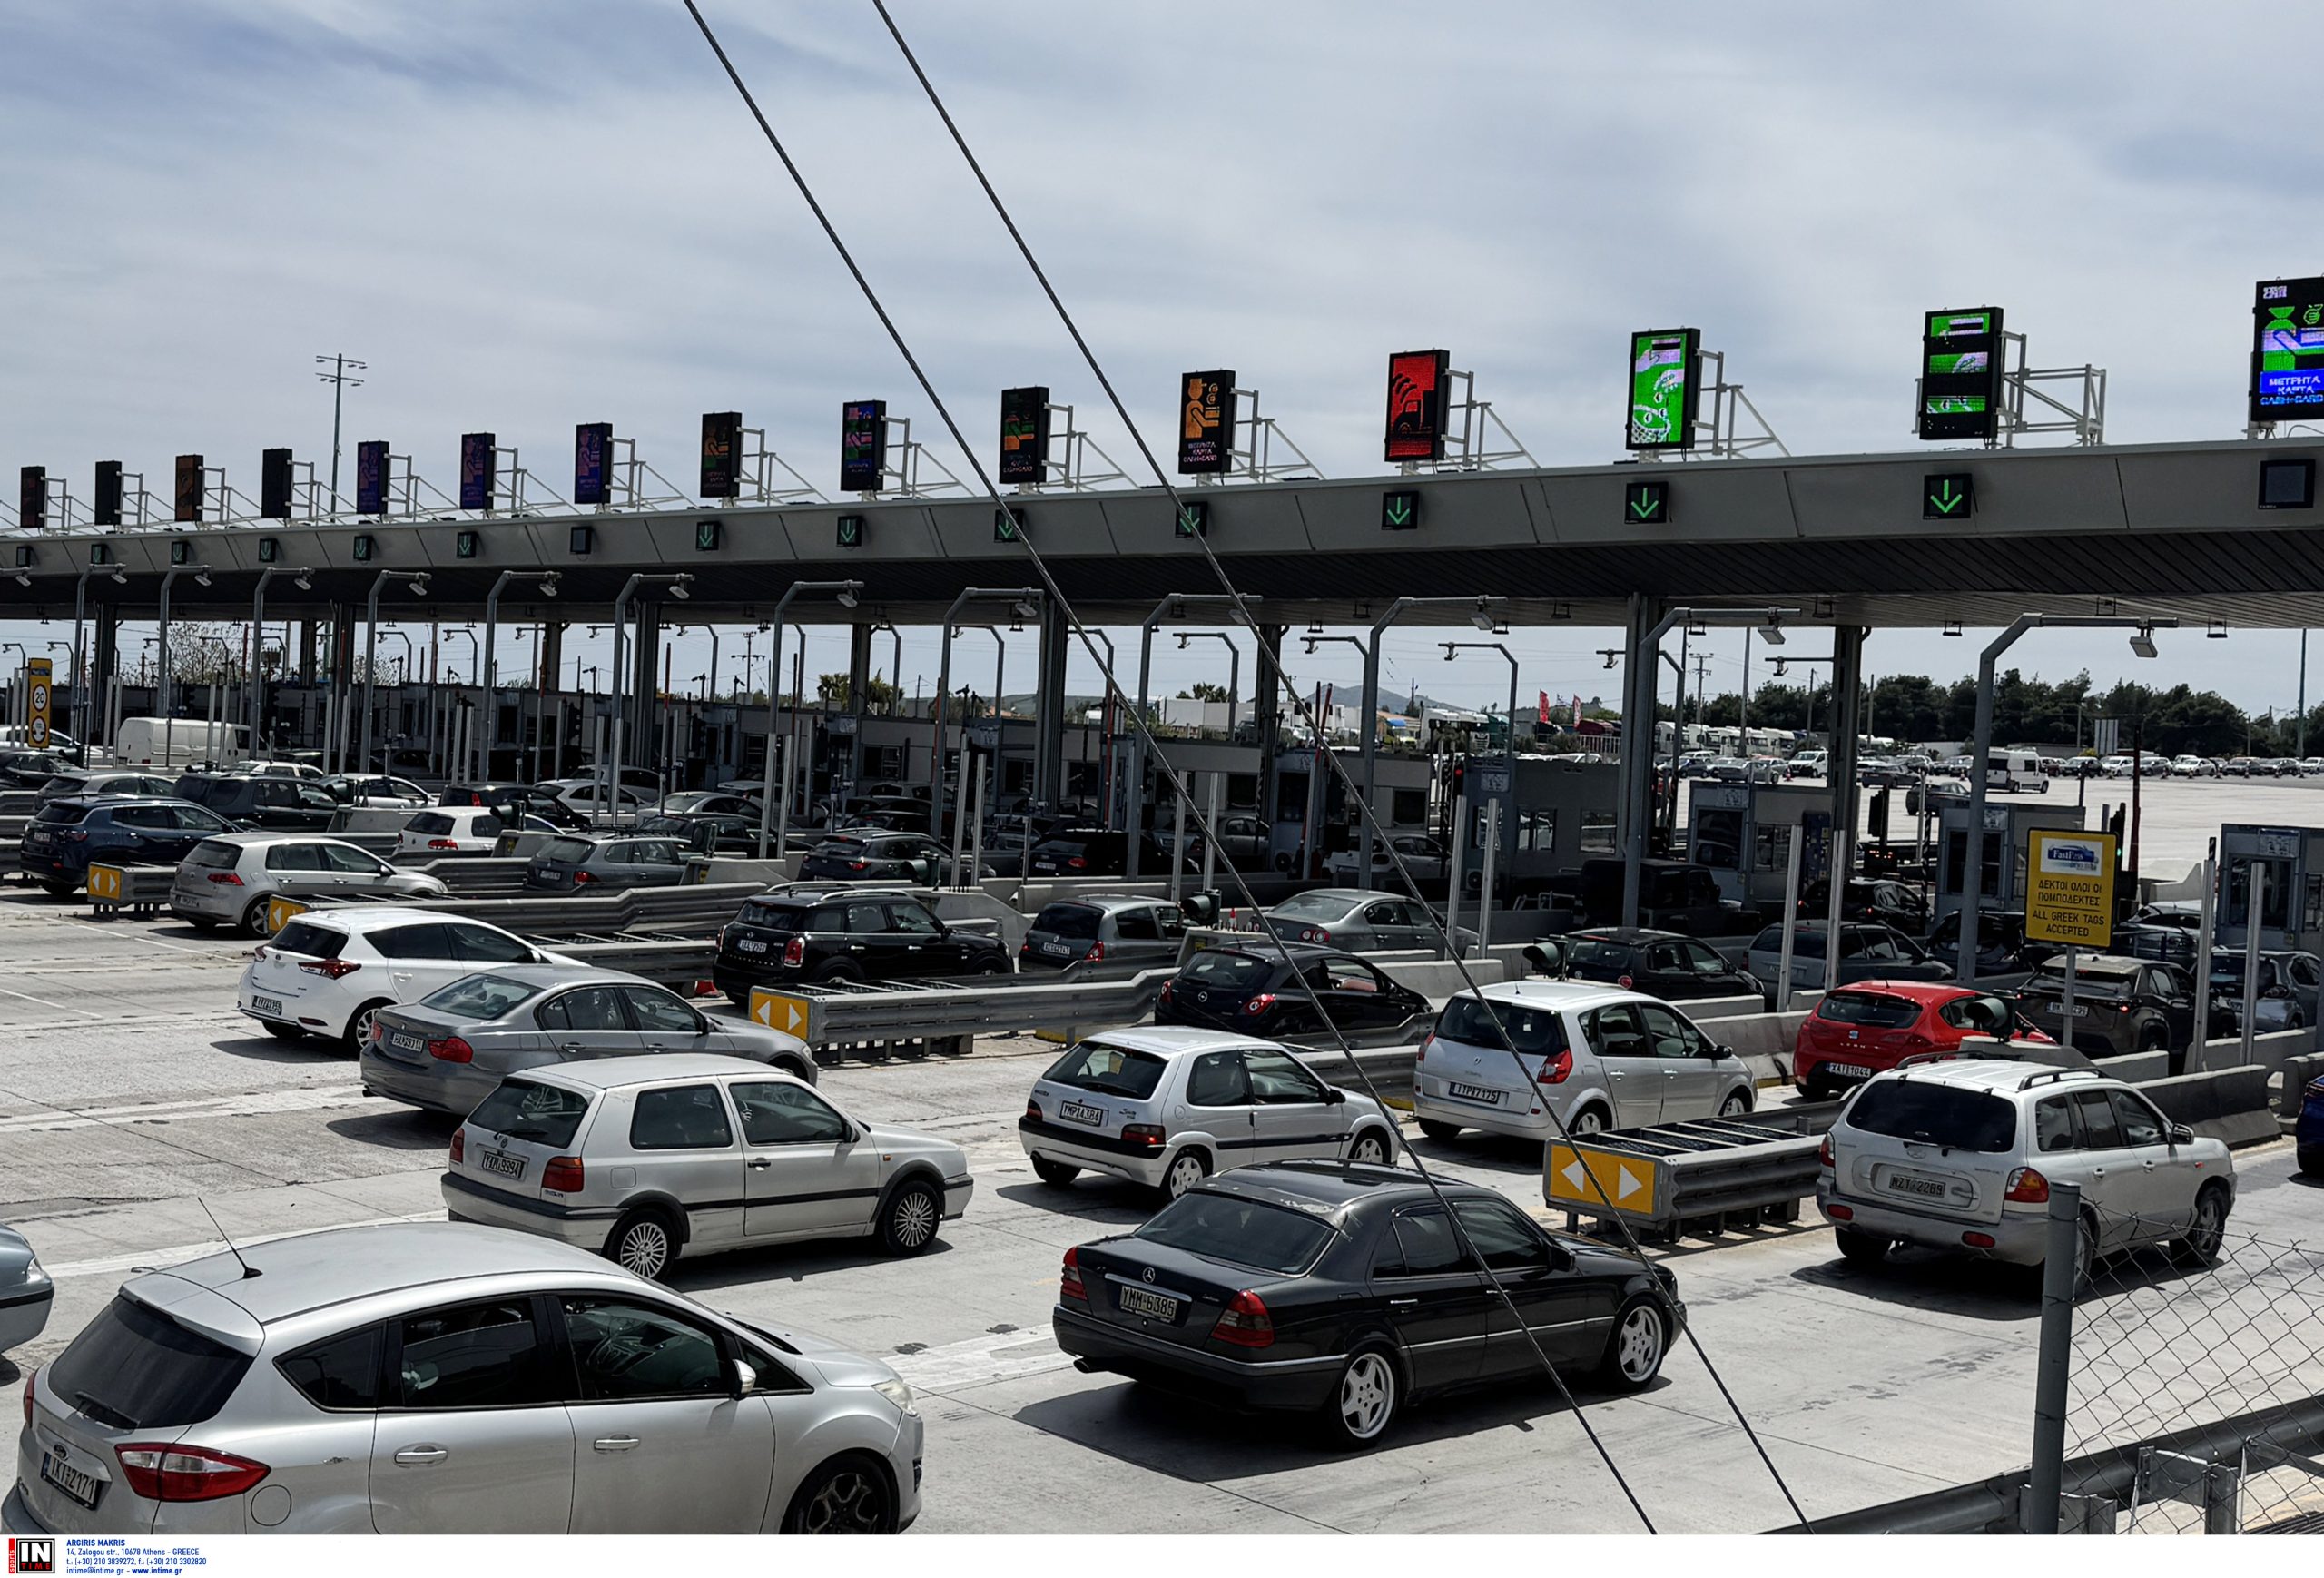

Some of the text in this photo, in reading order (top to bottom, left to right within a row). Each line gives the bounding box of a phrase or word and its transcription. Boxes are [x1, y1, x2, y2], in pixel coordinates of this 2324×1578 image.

[35, 692, 44, 704] 20
[2038, 880, 2102, 894] ΔΕΚΤΟΙ ΟΛΟΙ ΟΙ
[2038, 892, 2101, 906] ΠΟΜΠΟΔΕΚΤΕΣ
[2034, 910, 2104, 925] ALL GREEK TAGS
[2046, 924, 2090, 937] ACCEPTED
